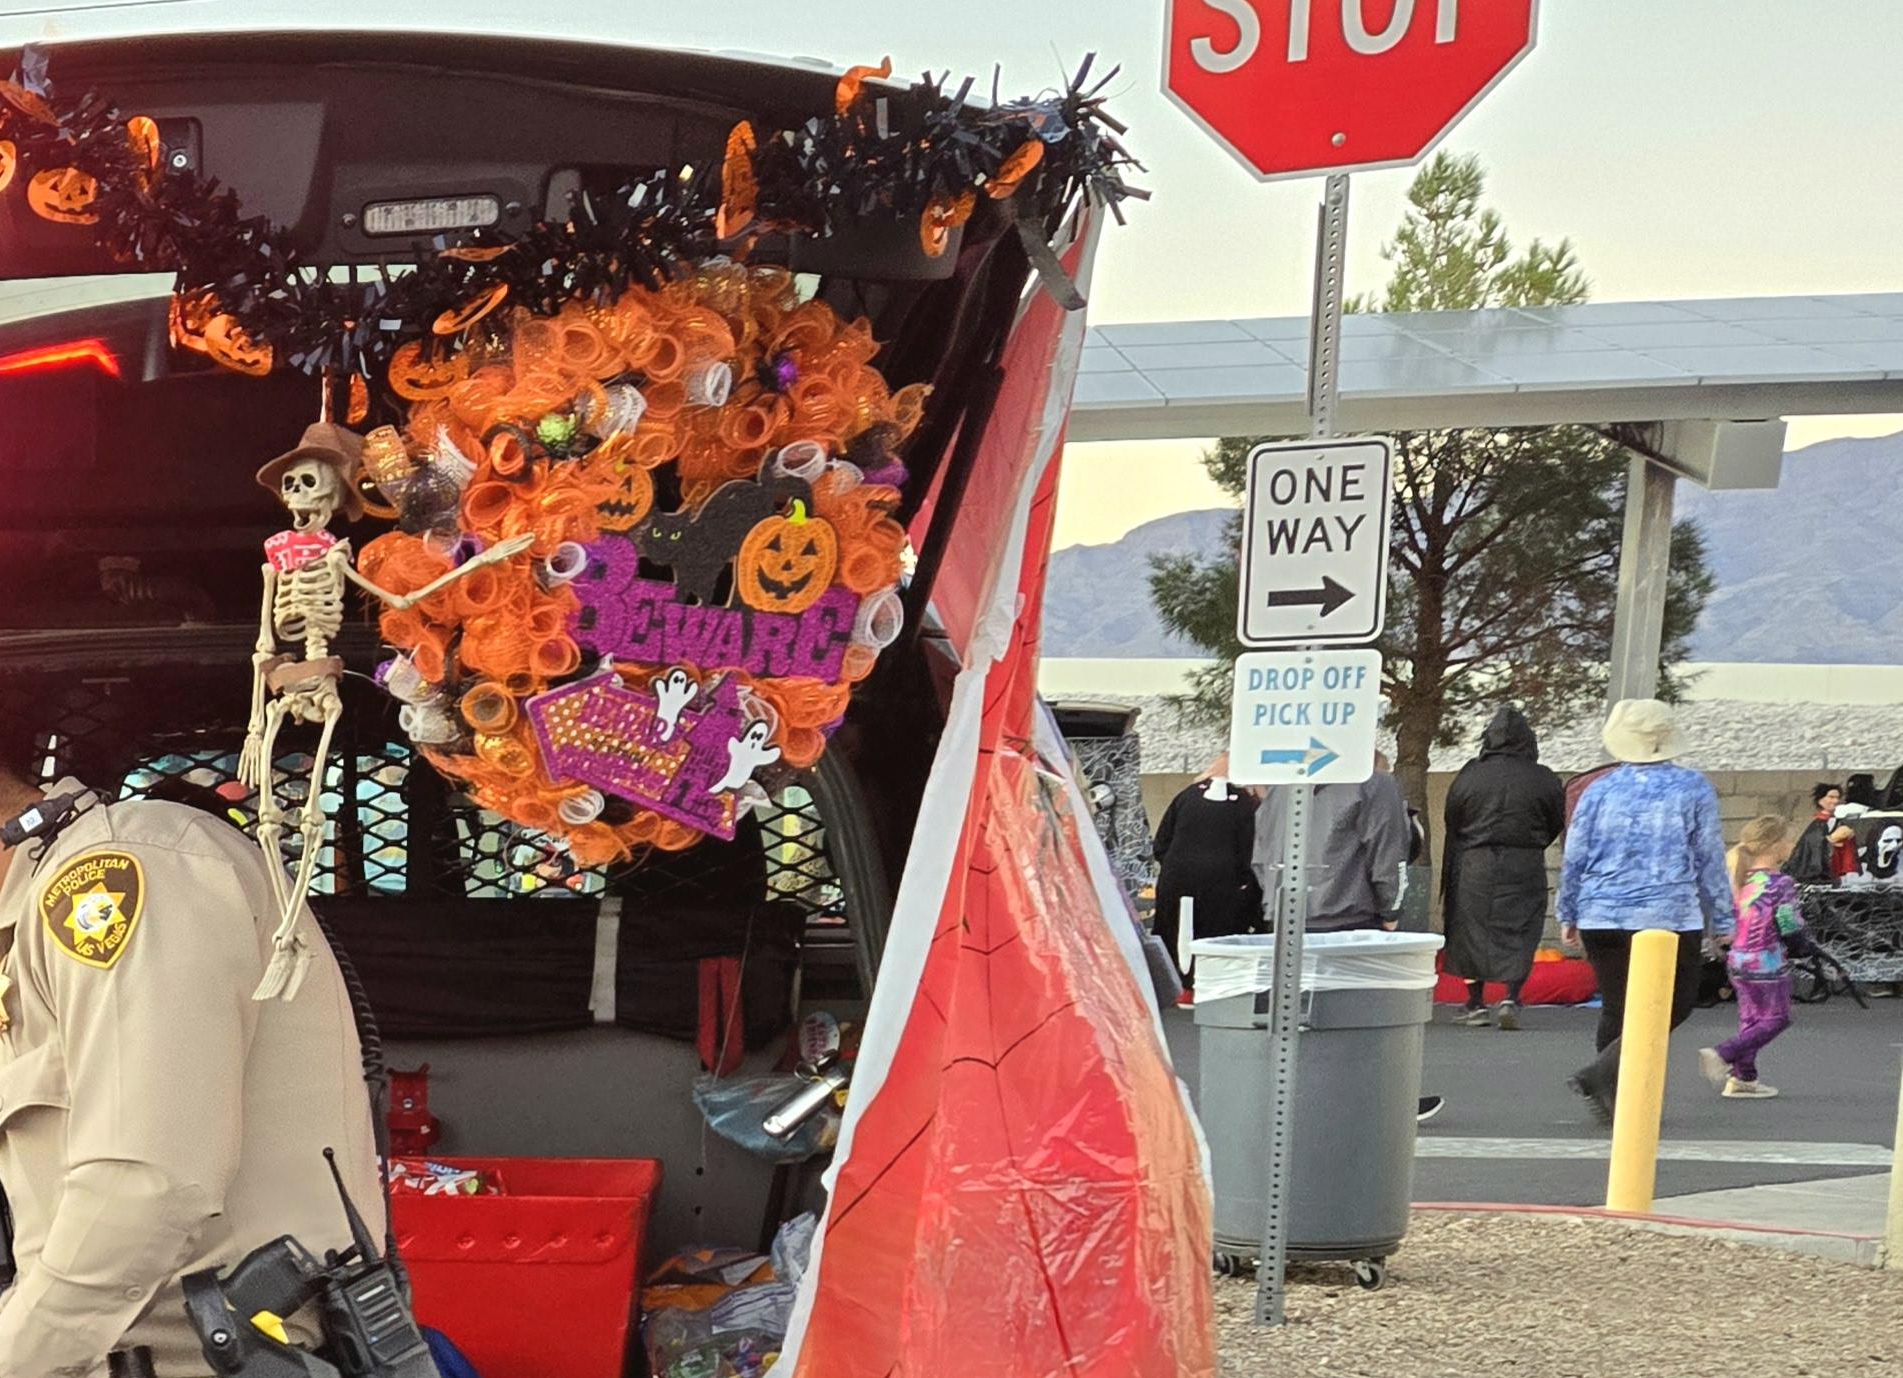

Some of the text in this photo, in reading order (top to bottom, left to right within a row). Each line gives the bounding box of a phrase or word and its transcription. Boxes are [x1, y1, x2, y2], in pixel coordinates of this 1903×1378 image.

[1269, 464, 1366, 505] ONE
[1267, 513, 1367, 556] WAY
[571, 533, 861, 685] BEWARE
[1248, 666, 1367, 691] DROP OFF
[1253, 702, 1356, 727] PICK UP
[45, 858, 130, 908] METROPOLITAN
[63, 868, 106, 897] POLICE
[76, 922, 128, 957] LAS VEGAS
